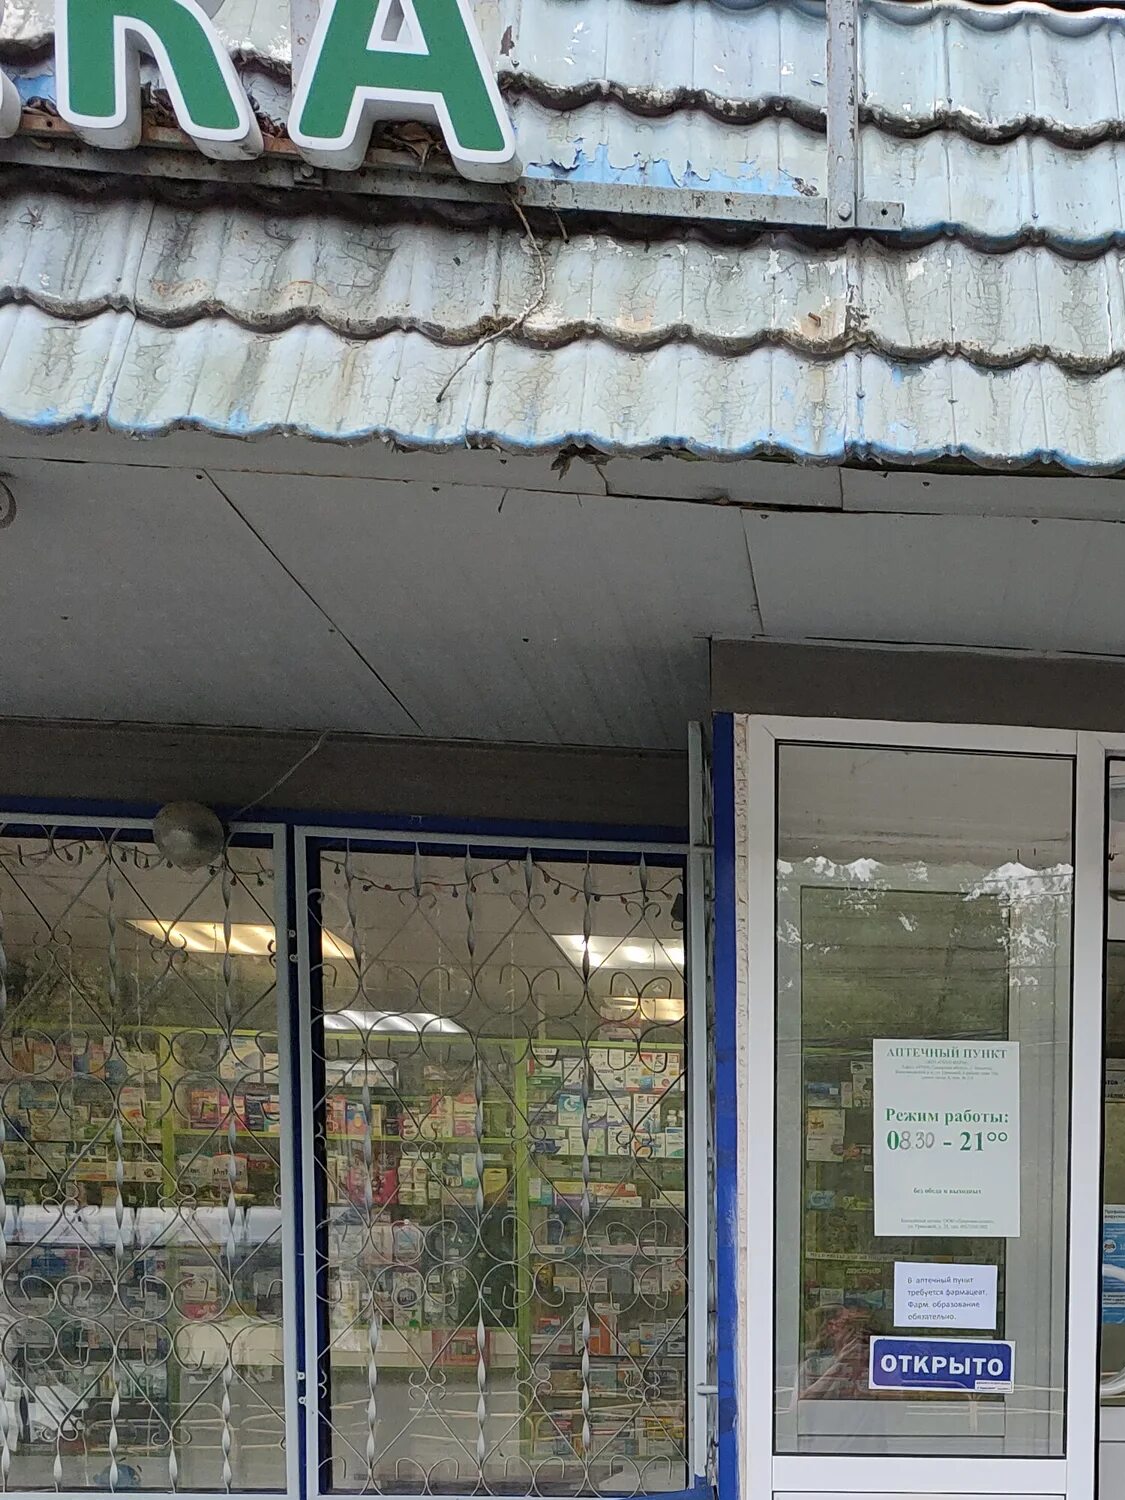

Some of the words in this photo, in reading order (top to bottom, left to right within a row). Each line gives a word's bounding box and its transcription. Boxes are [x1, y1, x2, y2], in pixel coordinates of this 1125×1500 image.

[0, 0, 520, 182] КА
[886, 1046, 959, 1058] АПТЕЧНЫЙ
[963, 1048, 1008, 1059] ПУНКТ
[886, 1108, 939, 1123] Режим
[944, 1110, 1009, 1125] работы:
[916, 1276, 951, 1284] аптечный
[952, 1277, 974, 1285] пункт
[907, 1288, 944, 1297] требуется
[932, 1300, 981, 1309] образование
[907, 1312, 957, 1321] обязательно.
[880, 1353, 1004, 1377] ОТКРЫТО
